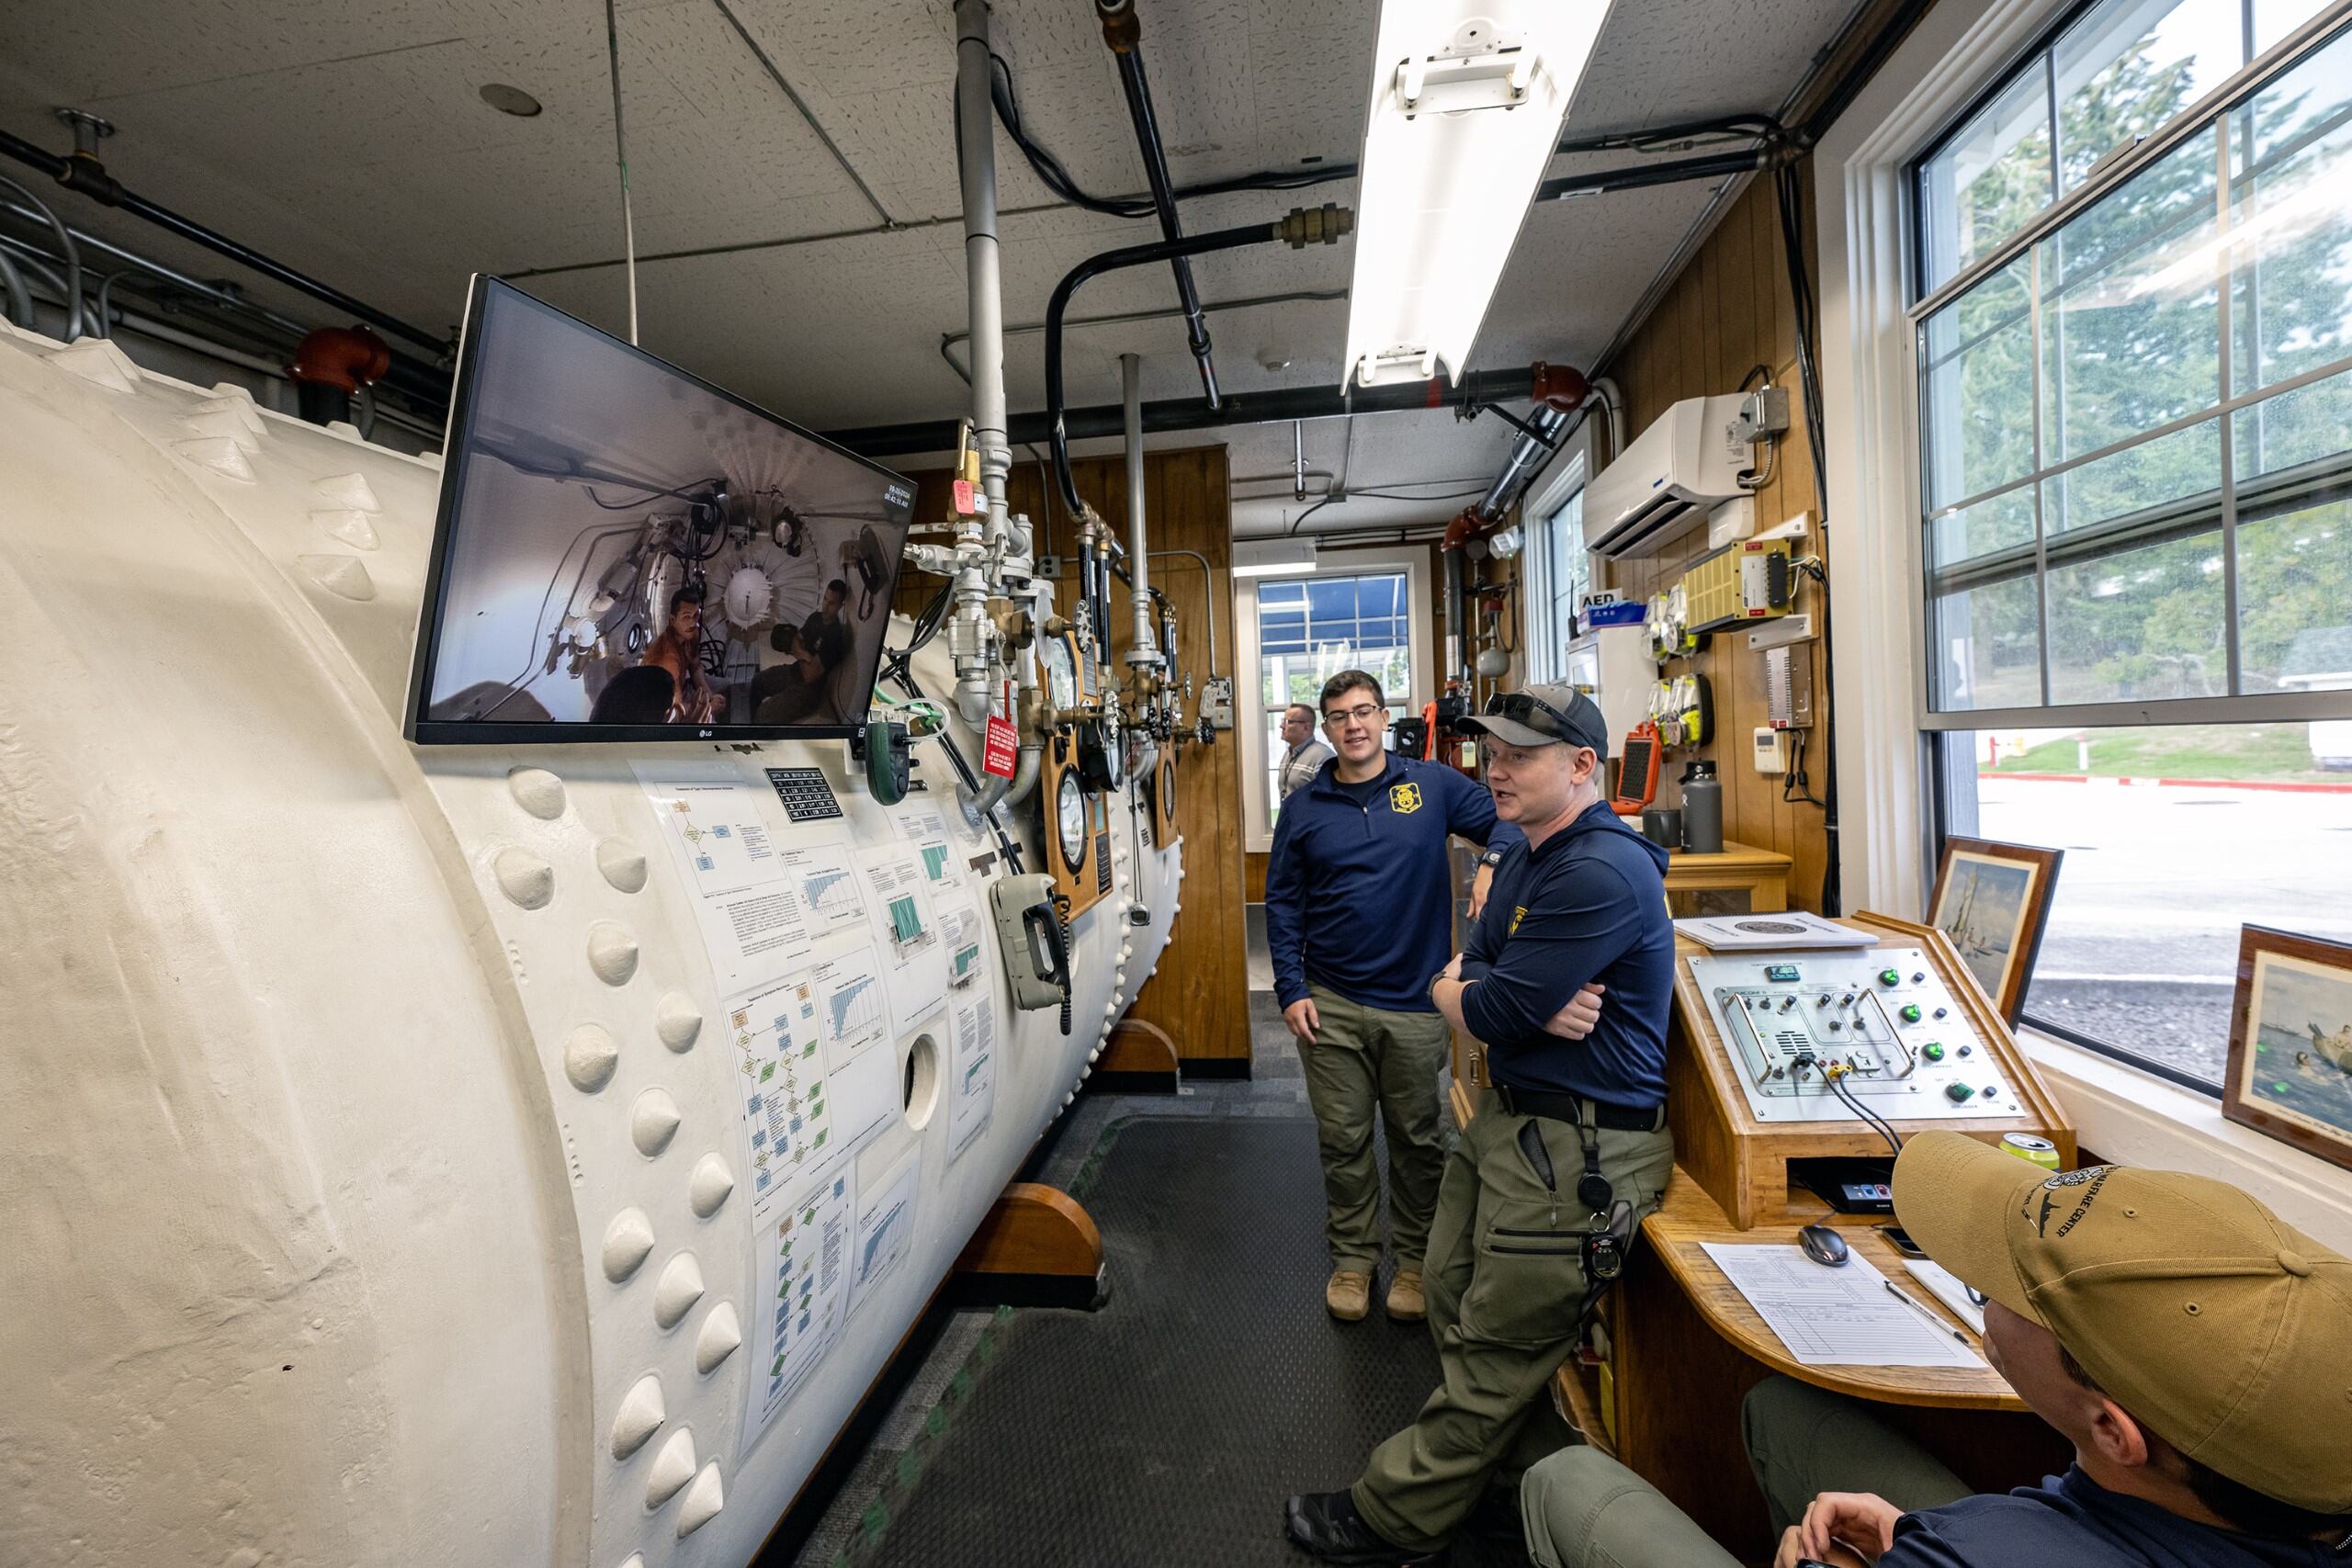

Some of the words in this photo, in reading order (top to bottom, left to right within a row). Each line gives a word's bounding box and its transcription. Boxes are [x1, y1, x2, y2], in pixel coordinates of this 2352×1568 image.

[1583, 593, 1614, 607] AED
[2080, 1173, 2110, 1209] WARFARE
[2055, 1207, 2086, 1237] CENTER
